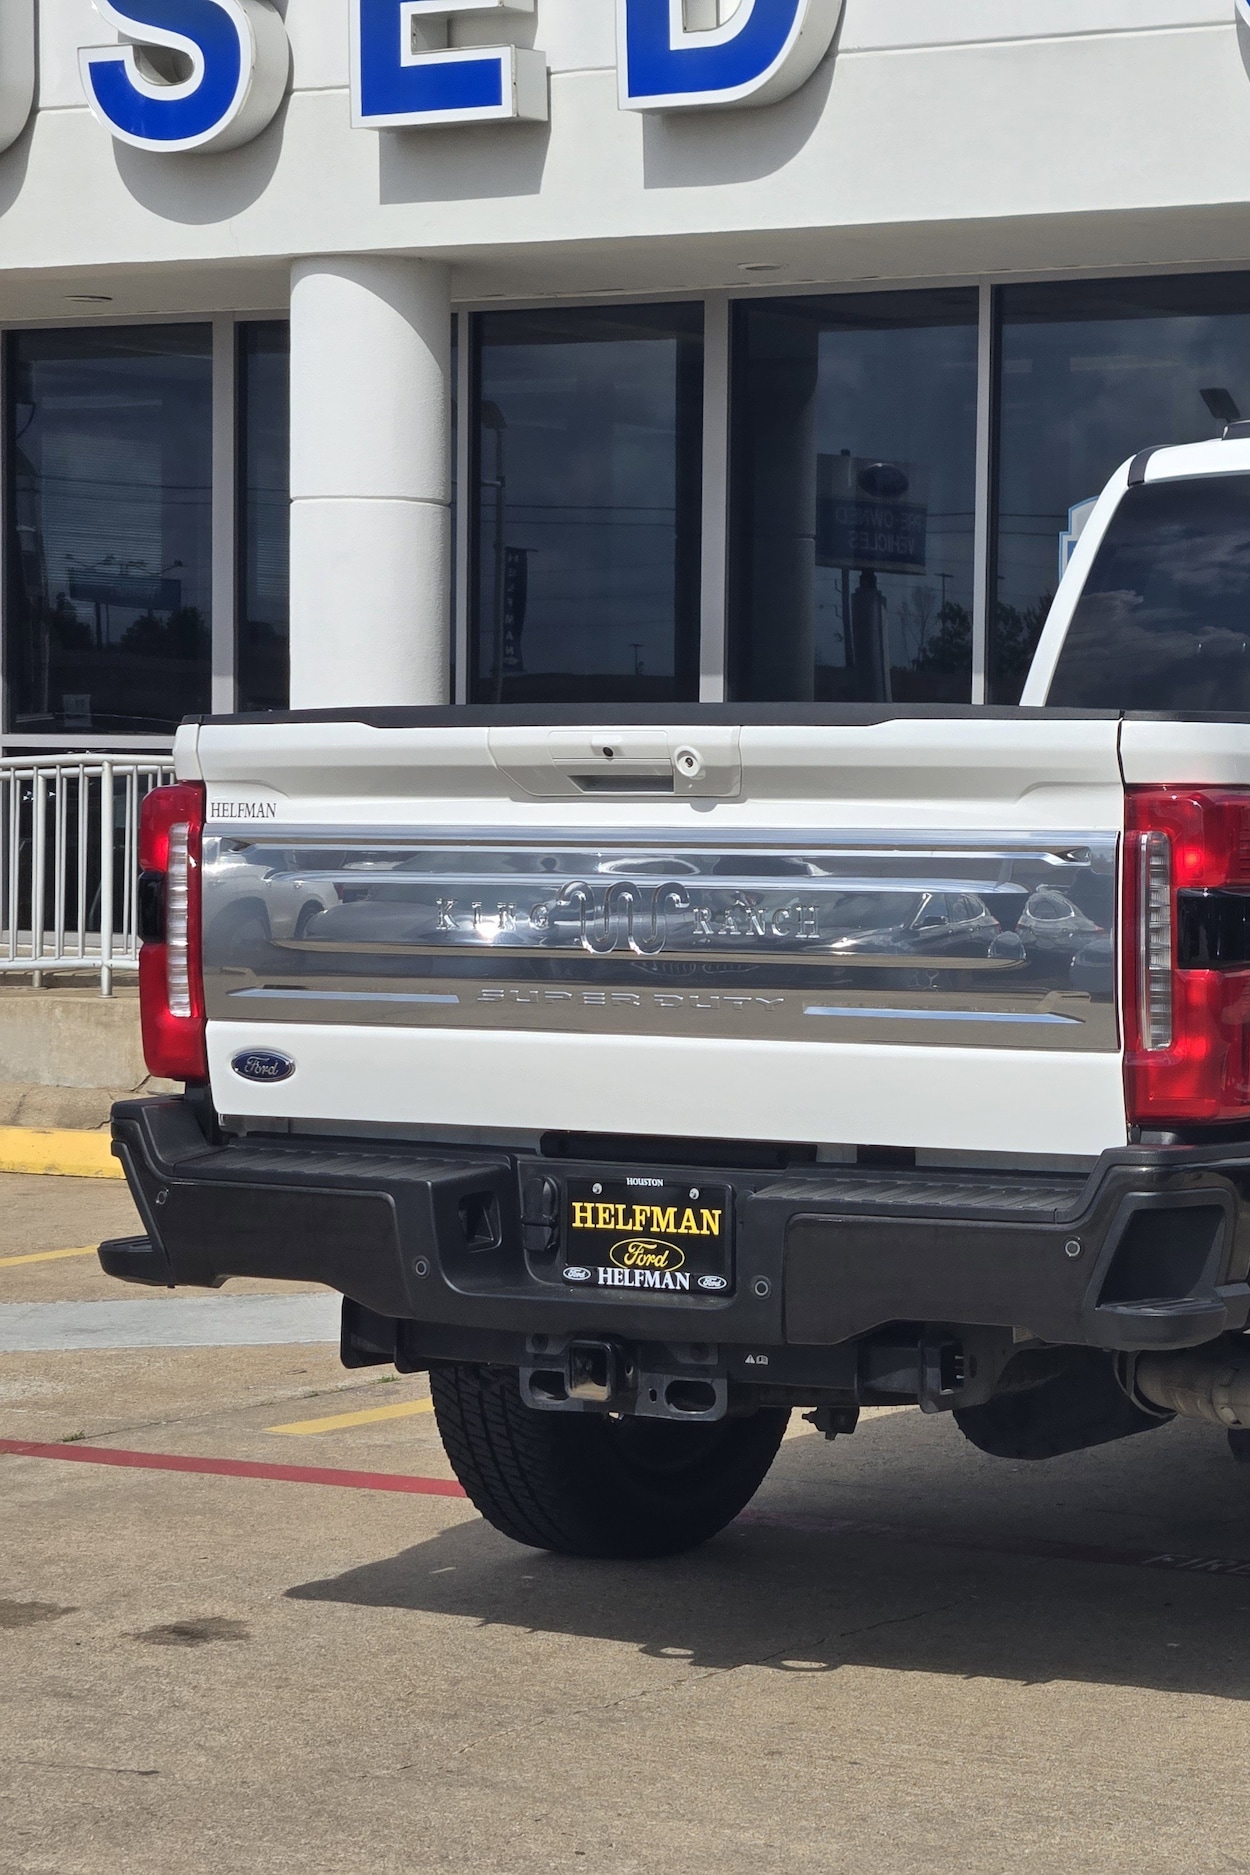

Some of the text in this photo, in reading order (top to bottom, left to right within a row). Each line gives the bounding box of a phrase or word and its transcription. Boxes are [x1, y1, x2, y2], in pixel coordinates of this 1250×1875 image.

[209, 801, 277, 820] HELFMAN
[435, 896, 822, 939] KING RANCH
[477, 988, 786, 1013] SUPER DUTY
[625, 1177, 664, 1188] HOUSTON
[571, 1201, 722, 1236] HELFMAN
[623, 1241, 669, 1268] Ford
[597, 1267, 690, 1290] HELFMAN
